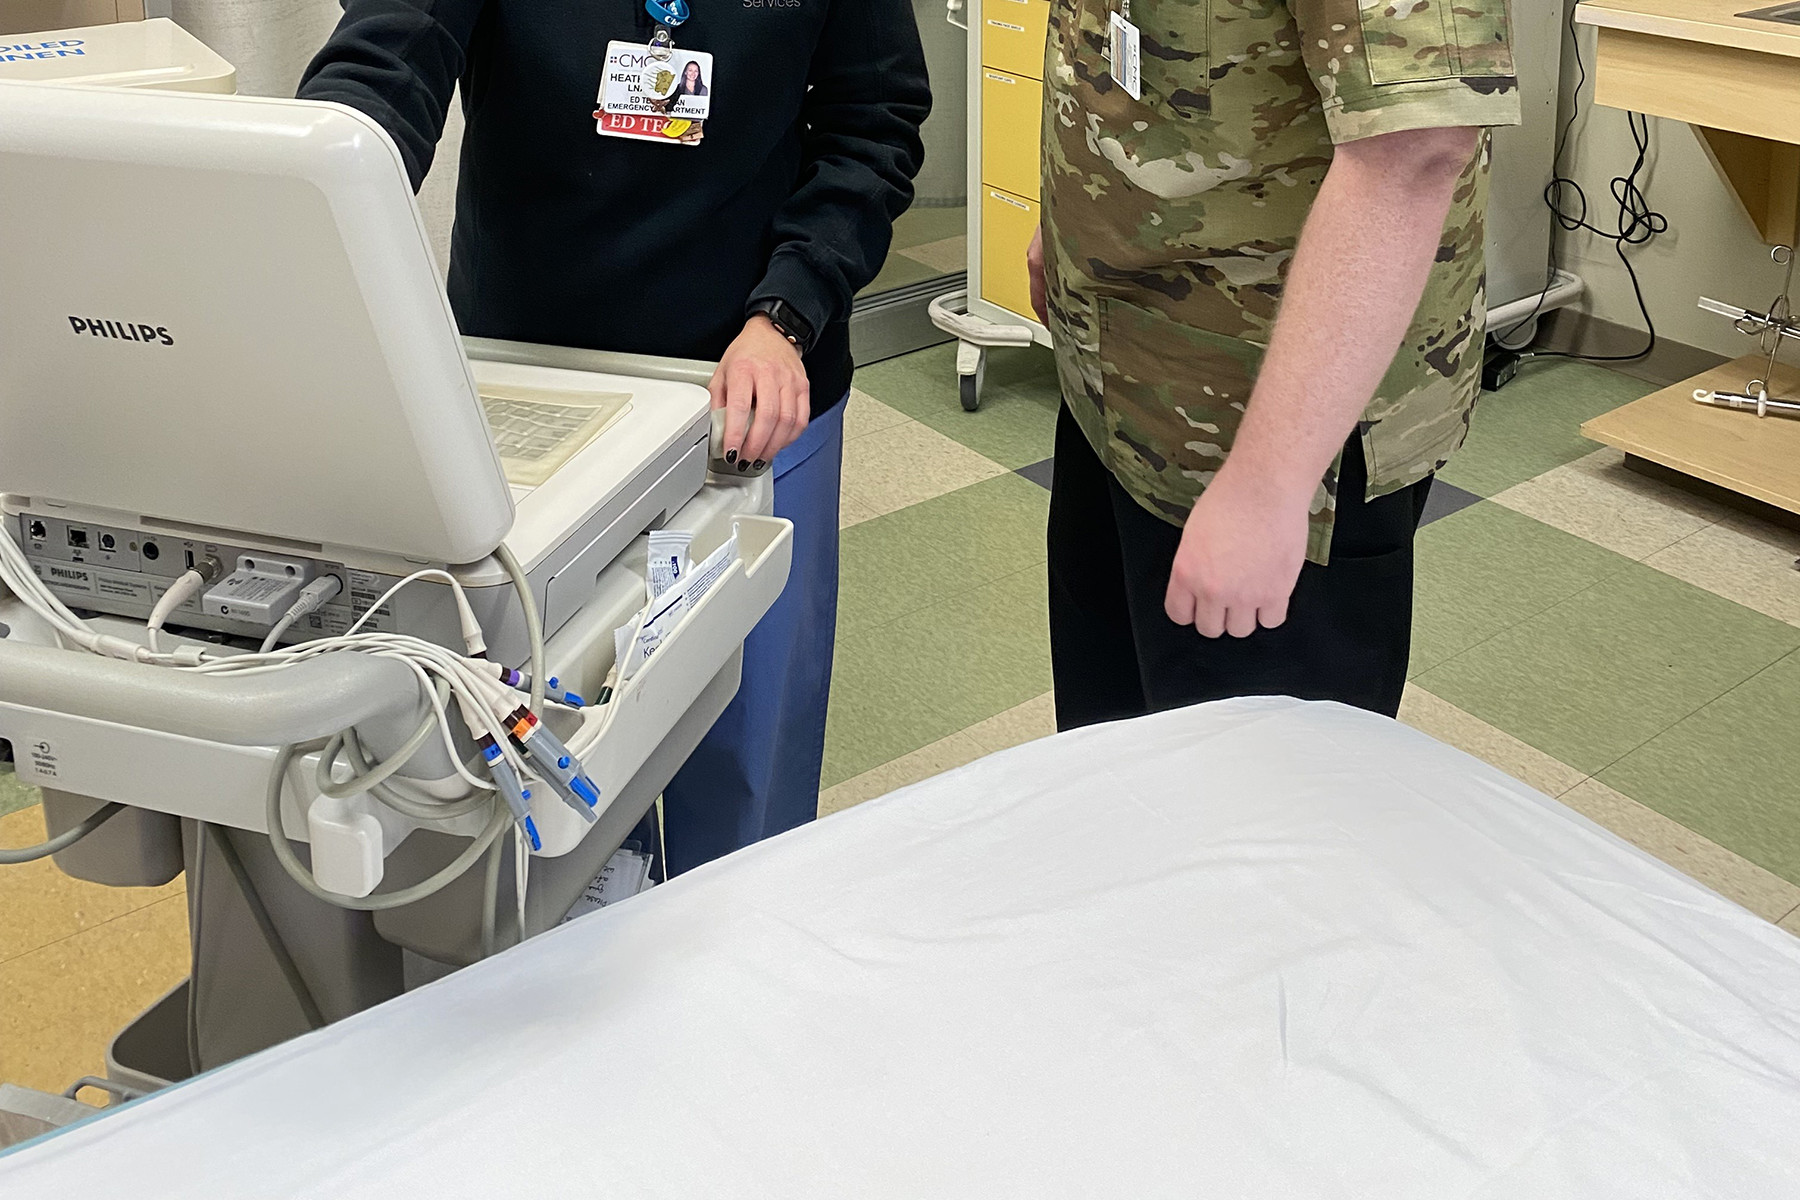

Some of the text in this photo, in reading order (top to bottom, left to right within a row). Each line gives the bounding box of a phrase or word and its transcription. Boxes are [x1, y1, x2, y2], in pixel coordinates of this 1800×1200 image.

[628, 84, 643, 92] LN
[630, 96, 641, 104] ED
[607, 103, 655, 113] EMERGENCY
[610, 114, 636, 130] ED
[68, 316, 174, 346] PHILIPS
[51, 567, 88, 581] PHILIPS
